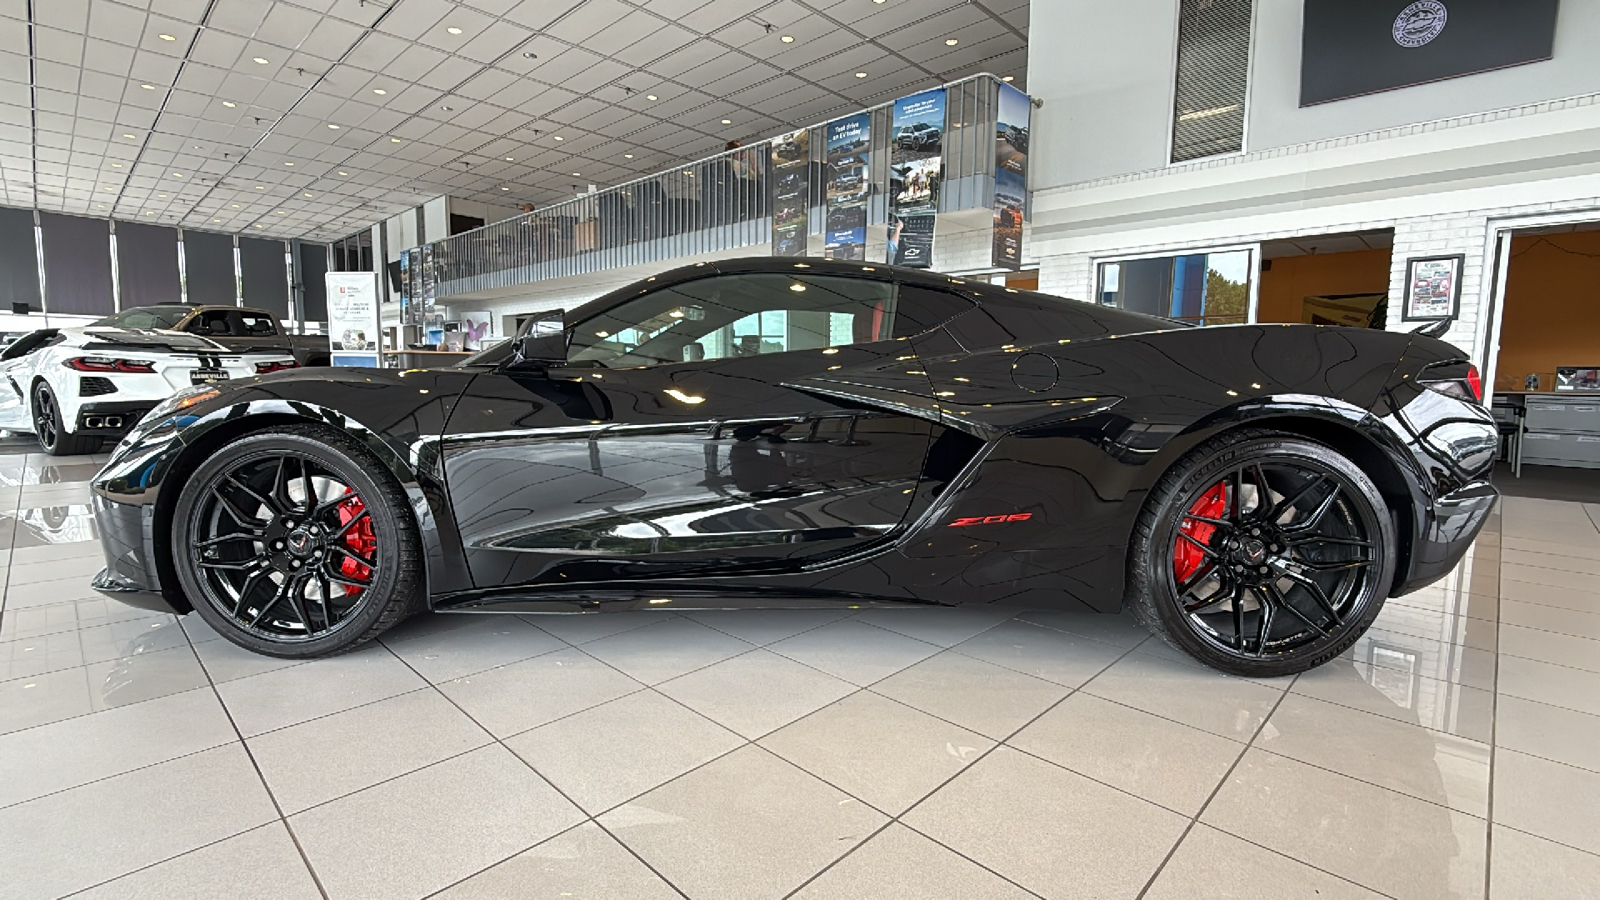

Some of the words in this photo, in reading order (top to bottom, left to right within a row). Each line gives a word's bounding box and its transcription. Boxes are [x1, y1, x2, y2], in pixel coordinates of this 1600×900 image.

[835, 125, 846, 133] Test
[846, 121, 859, 131] drive
[840, 131, 847, 139] EV
[847, 128, 862, 138] today
[947, 512, 1033, 527] Z06
